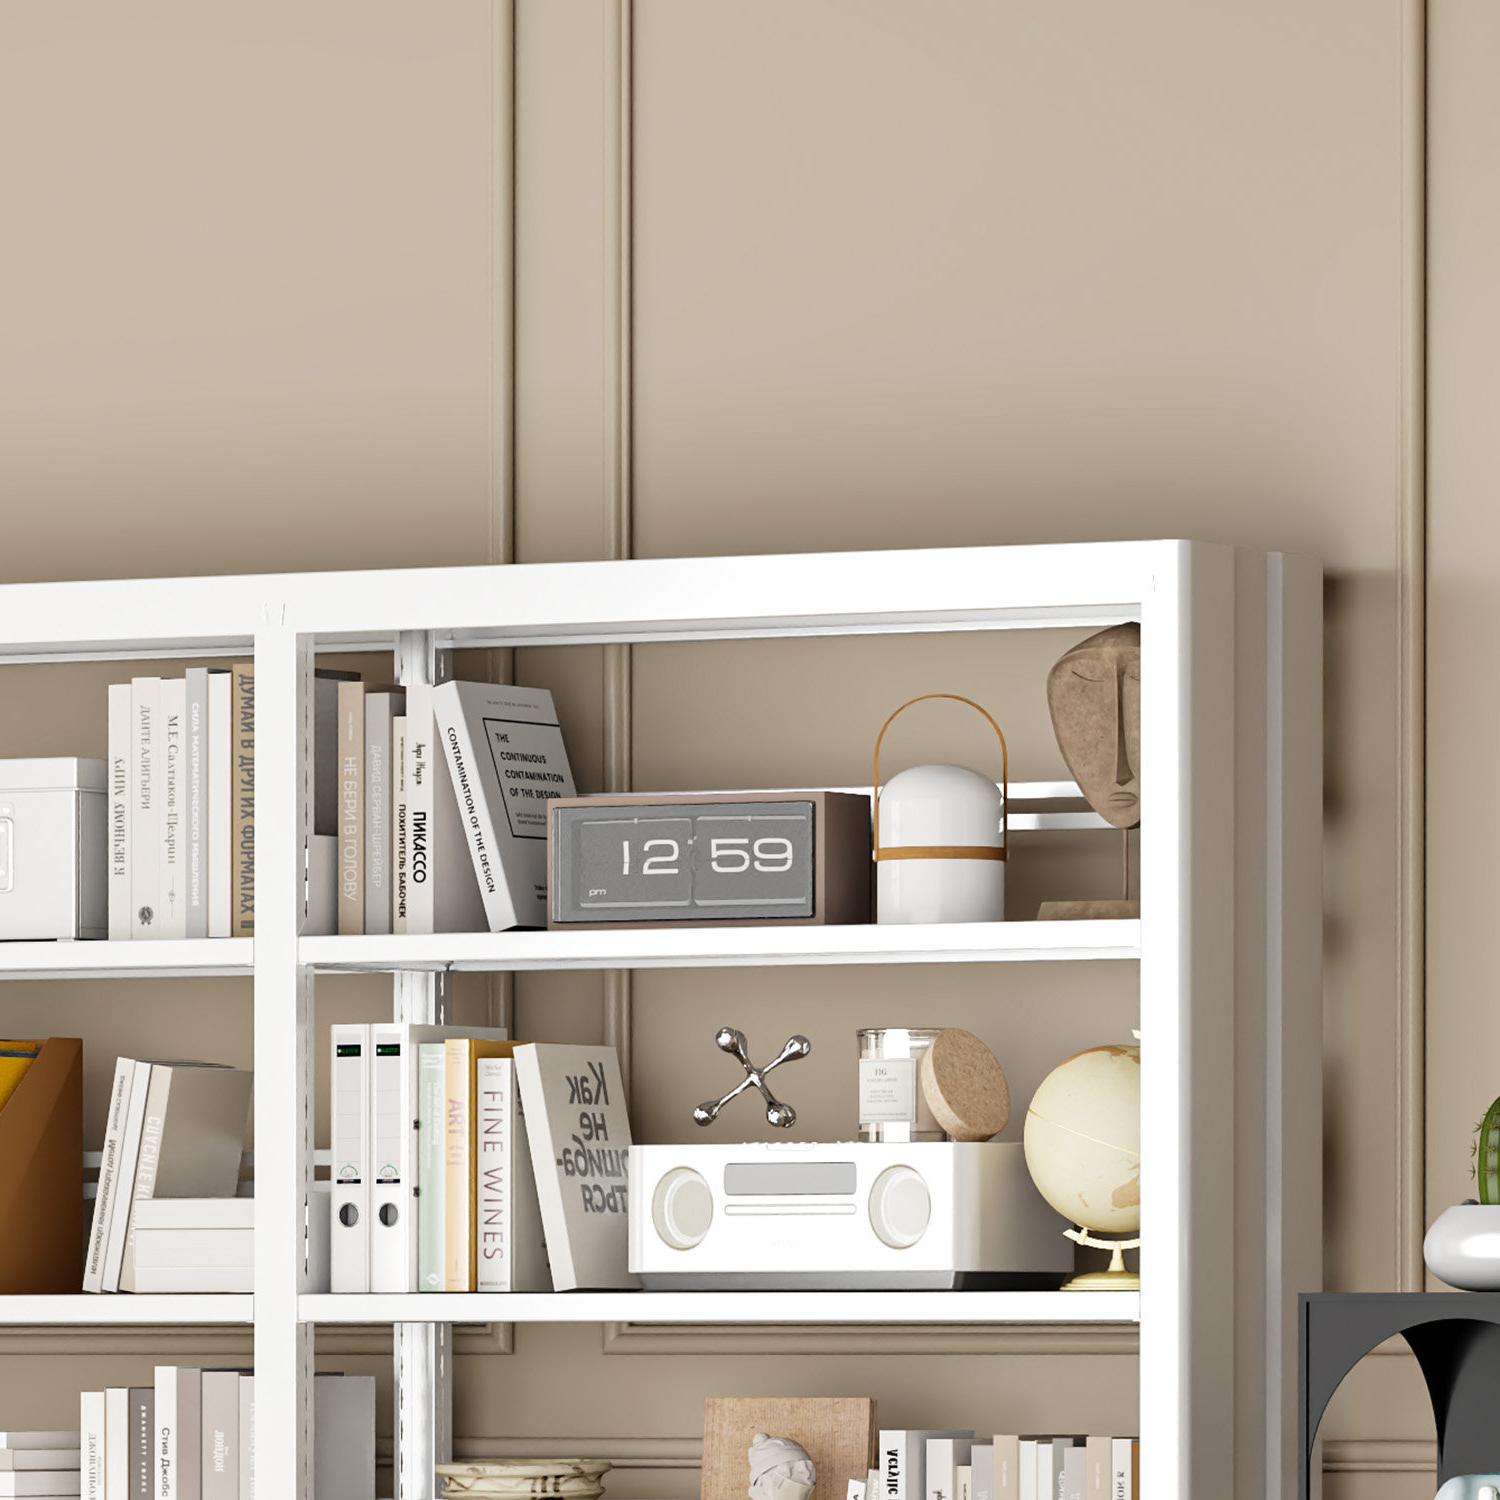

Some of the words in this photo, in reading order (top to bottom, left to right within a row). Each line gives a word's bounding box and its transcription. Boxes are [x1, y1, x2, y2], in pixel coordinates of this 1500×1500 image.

[495, 732, 510, 744] THE
[343, 756, 357, 776] НЕ
[446, 727, 475, 816] CONTAMINATION
[500, 751, 547, 765] CONTINUOUS
[504, 768, 564, 784] CONTAMINATION
[343, 780, 357, 820] БЕРИ
[343, 824, 357, 835] В
[470, 817, 480, 829] OF
[413, 811, 427, 883] ПИКАССО
[473, 830, 485, 849] THE
[343, 839, 358, 901] ГОЛОВУ
[621, 838, 680, 876] 12
[709, 837, 793, 873] 59
[478, 850, 496, 894] DESIGN
[588, 888, 607, 898] pm
[483, 1090, 504, 1153] FINE
[483, 1166, 504, 1260] WINES
